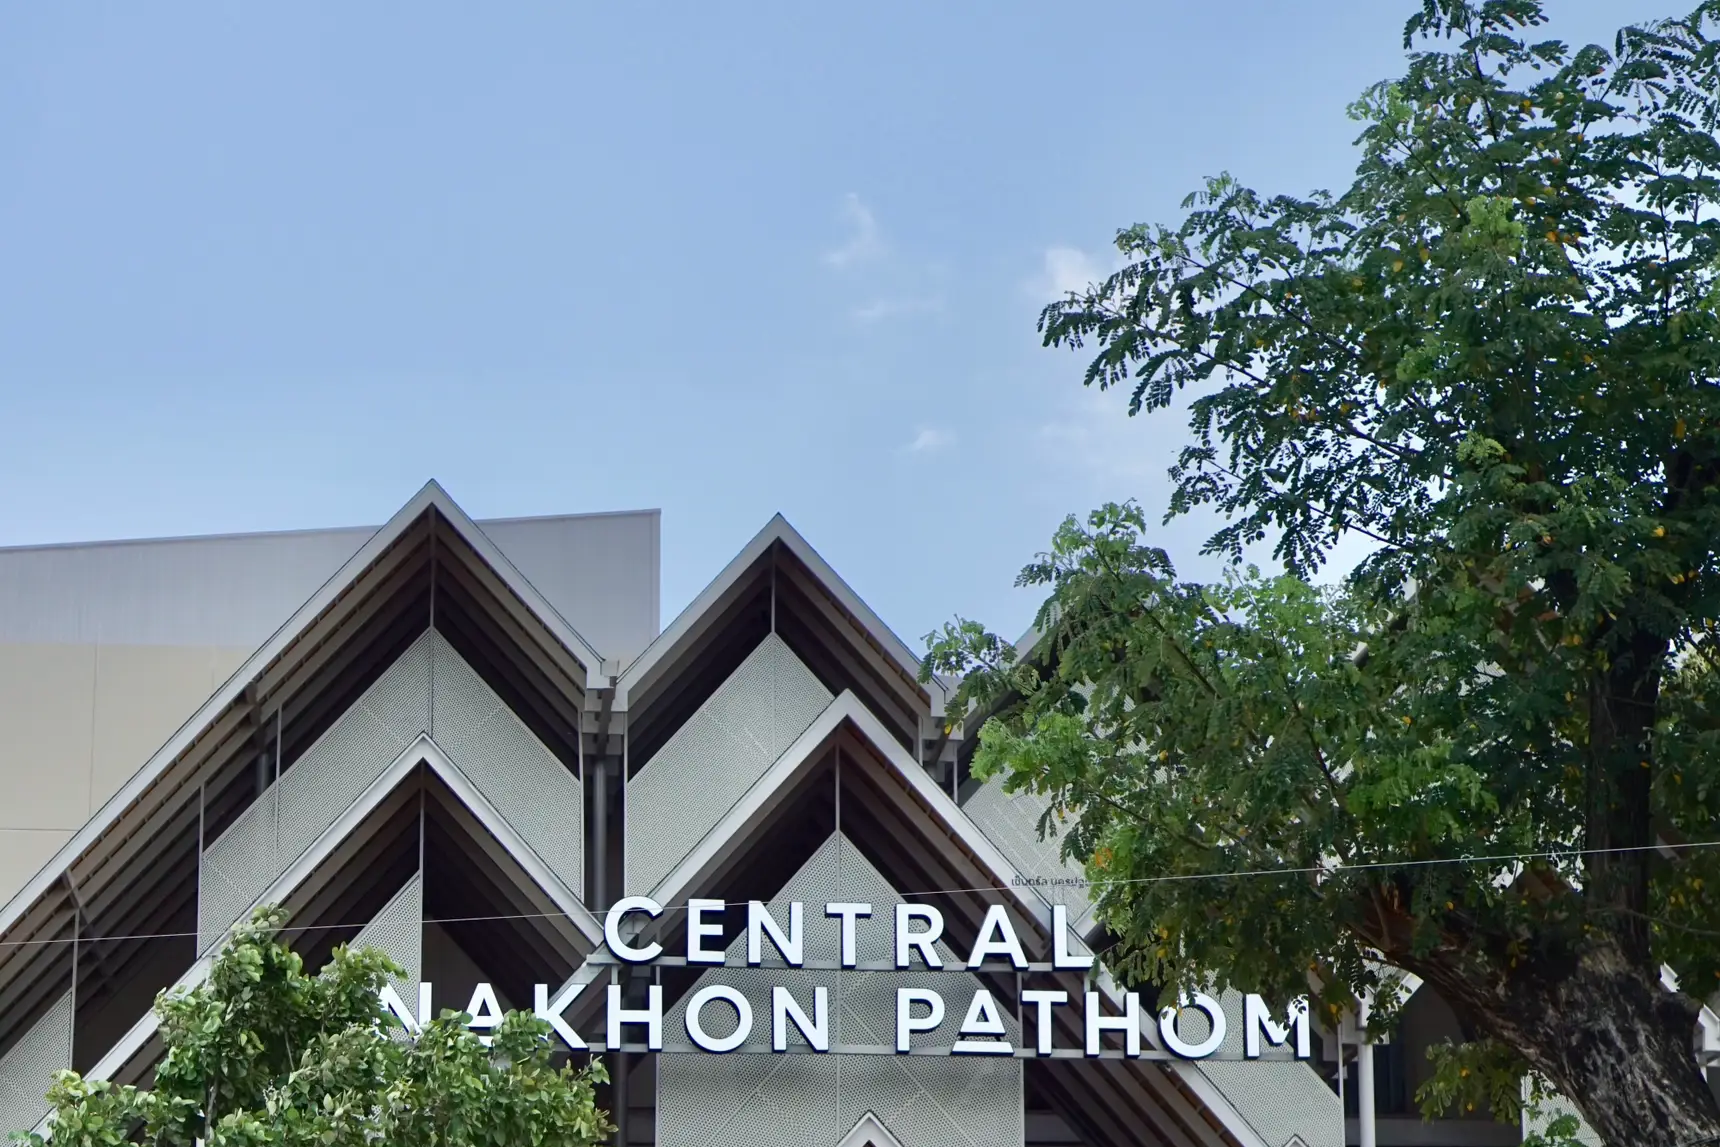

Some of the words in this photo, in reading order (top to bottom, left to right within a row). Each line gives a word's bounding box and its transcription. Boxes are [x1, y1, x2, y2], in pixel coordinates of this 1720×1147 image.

[603, 896, 1096, 971] CENTRAL
[374, 981, 829, 1053] NAKHON
[895, 987, 1311, 1060] PATHOM
